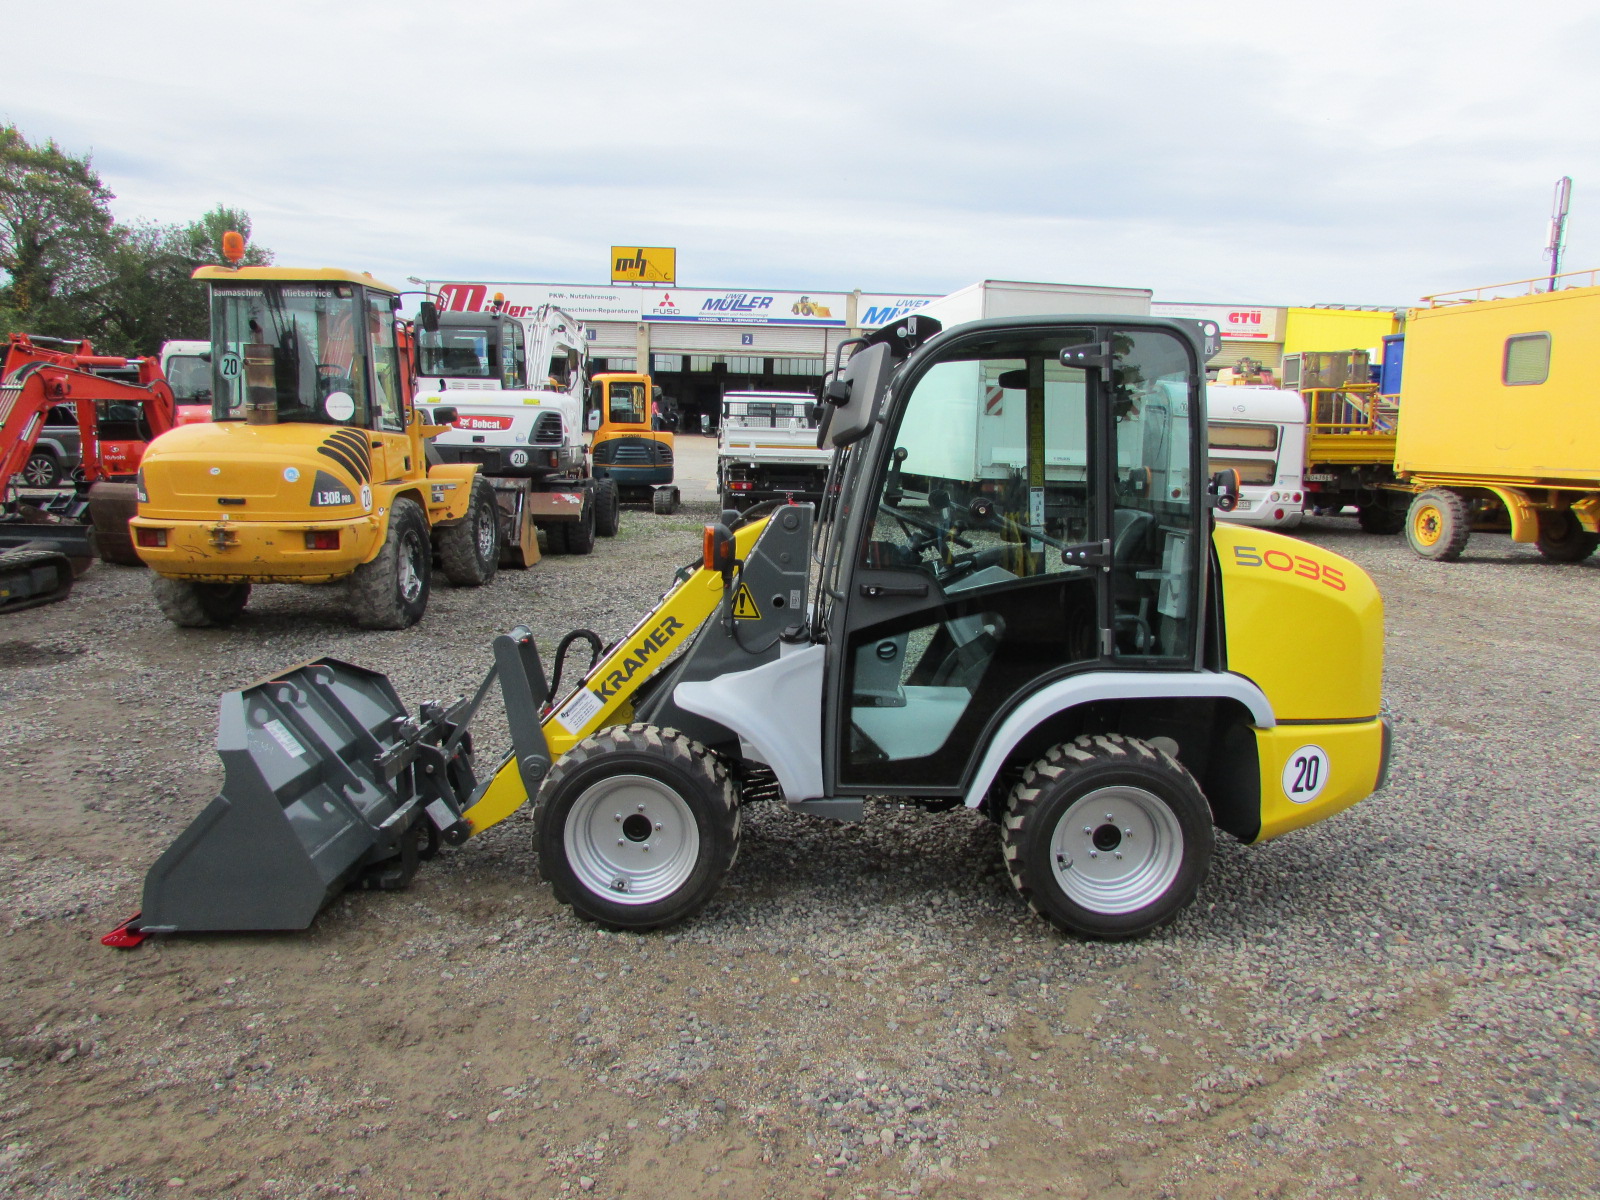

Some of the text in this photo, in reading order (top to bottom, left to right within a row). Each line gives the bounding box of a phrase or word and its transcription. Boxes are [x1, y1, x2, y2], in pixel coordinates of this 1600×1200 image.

[282, 288, 332, 298] Mietservice
[548, 292, 621, 301] PKW-, Nutzfahrzeuge-,
[895, 299, 922, 308] UWE
[553, 306, 639, 315] maschinen-Reparaturen
[1228, 310, 1262, 325] GTÜ
[744, 335, 751, 344] 2
[223, 358, 238, 375] 20
[472, 419, 500, 429] Bobcat
[514, 453, 525, 464] 20
[317, 491, 341, 505] L30B
[362, 489, 371, 508] 20
[1233, 545, 1347, 592] 5035
[592, 615, 685, 706] KRAMER
[1291, 754, 1320, 794] 20
